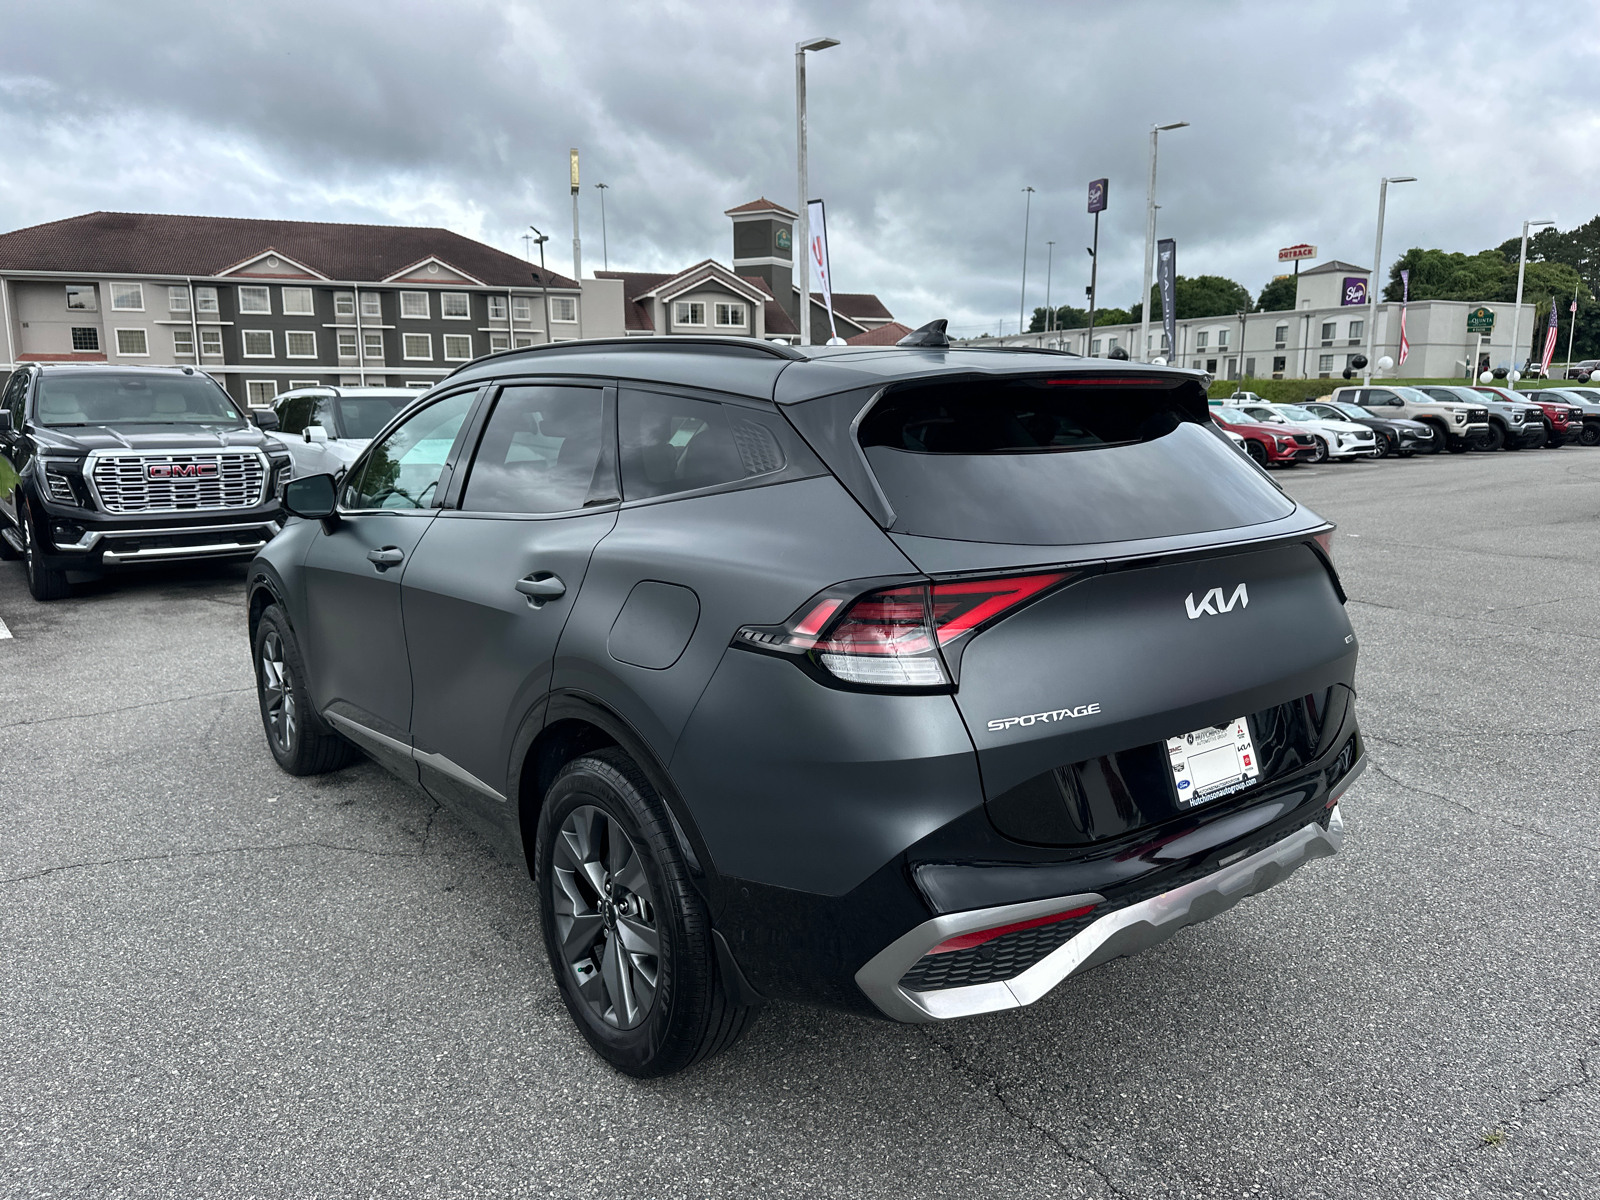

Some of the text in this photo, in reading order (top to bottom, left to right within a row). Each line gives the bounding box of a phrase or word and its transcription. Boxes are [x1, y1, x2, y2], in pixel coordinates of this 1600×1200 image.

[1279, 248, 1313, 259] OUTBACK
[1346, 286, 1363, 300] Sleep
[149, 464, 218, 478] GMC
[1184, 582, 1249, 620] KIA
[987, 702, 1101, 732] SPORTAGE
[1189, 777, 1257, 808] Hutchinsonautogroup.com
